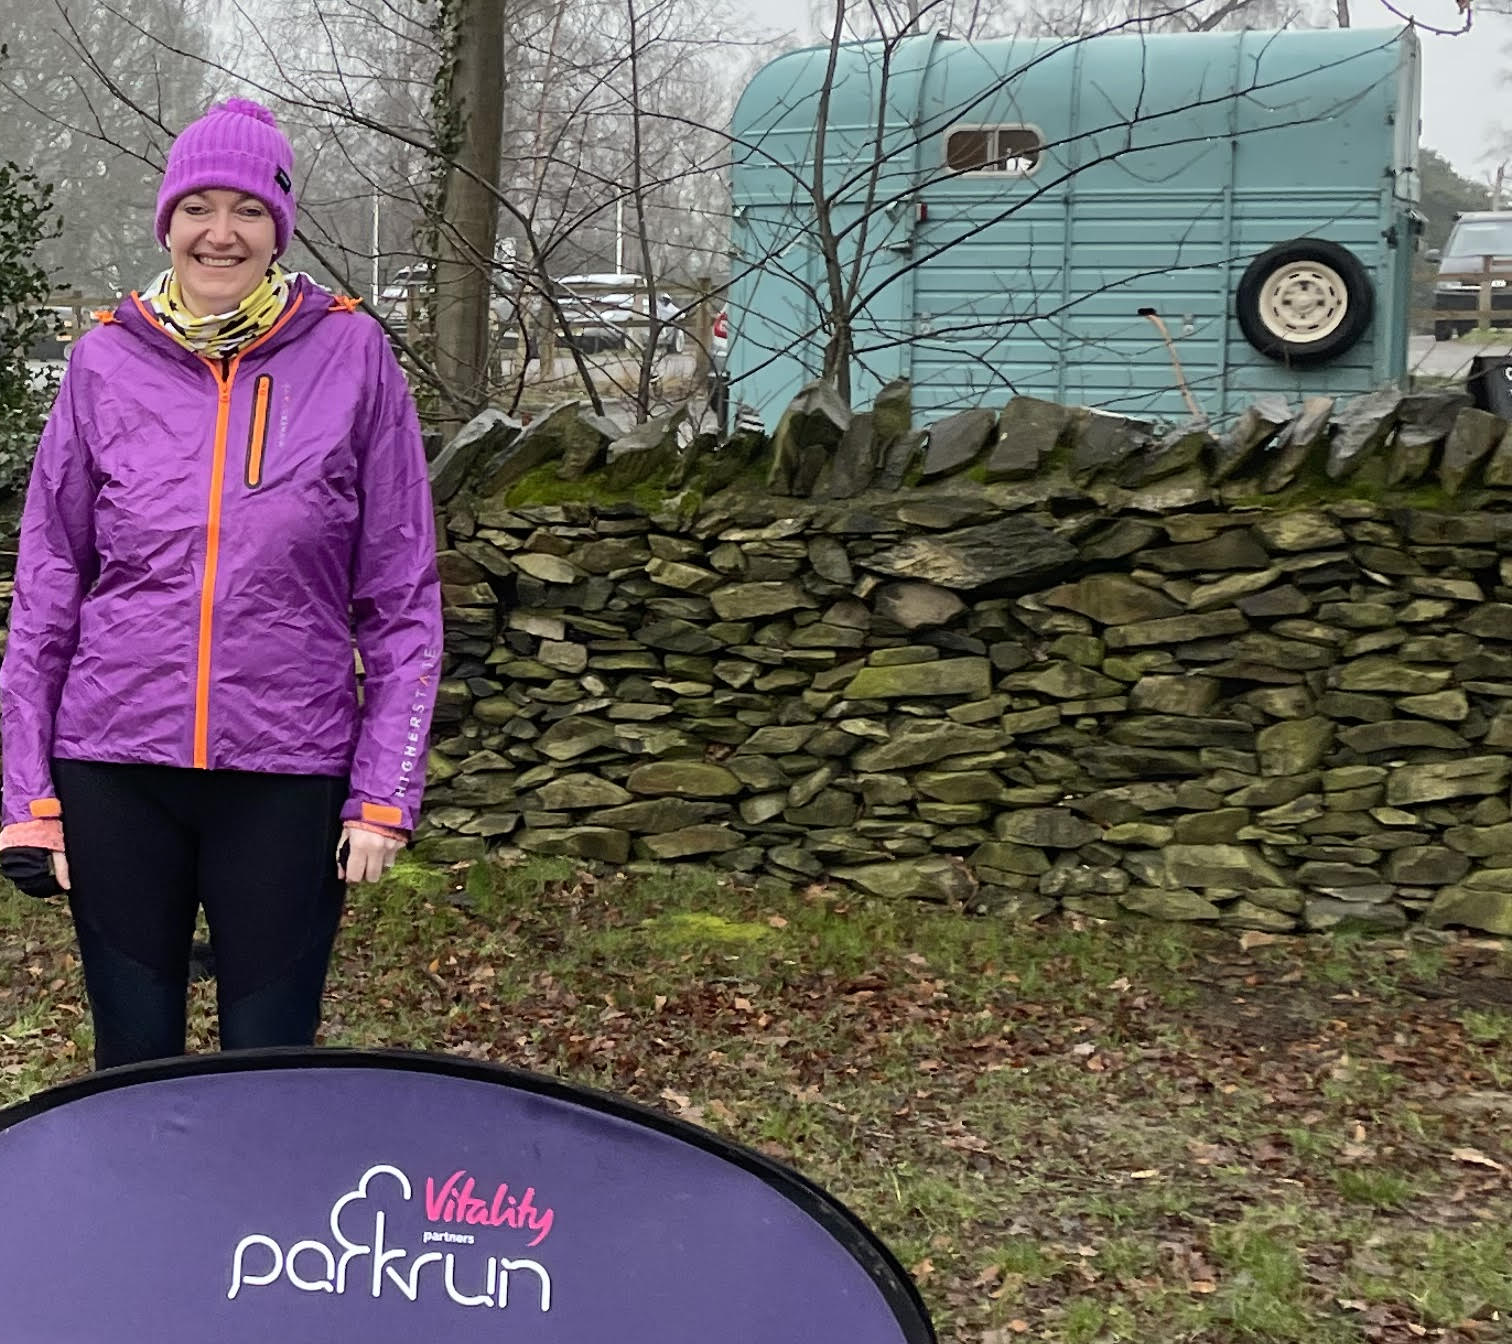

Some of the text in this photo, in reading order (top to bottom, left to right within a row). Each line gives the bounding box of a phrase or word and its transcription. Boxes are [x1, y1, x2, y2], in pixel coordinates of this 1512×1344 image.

[226, 1164, 552, 1313] parkrun
[422, 1231, 476, 1245] partners
[424, 1169, 555, 1247] Vitality
